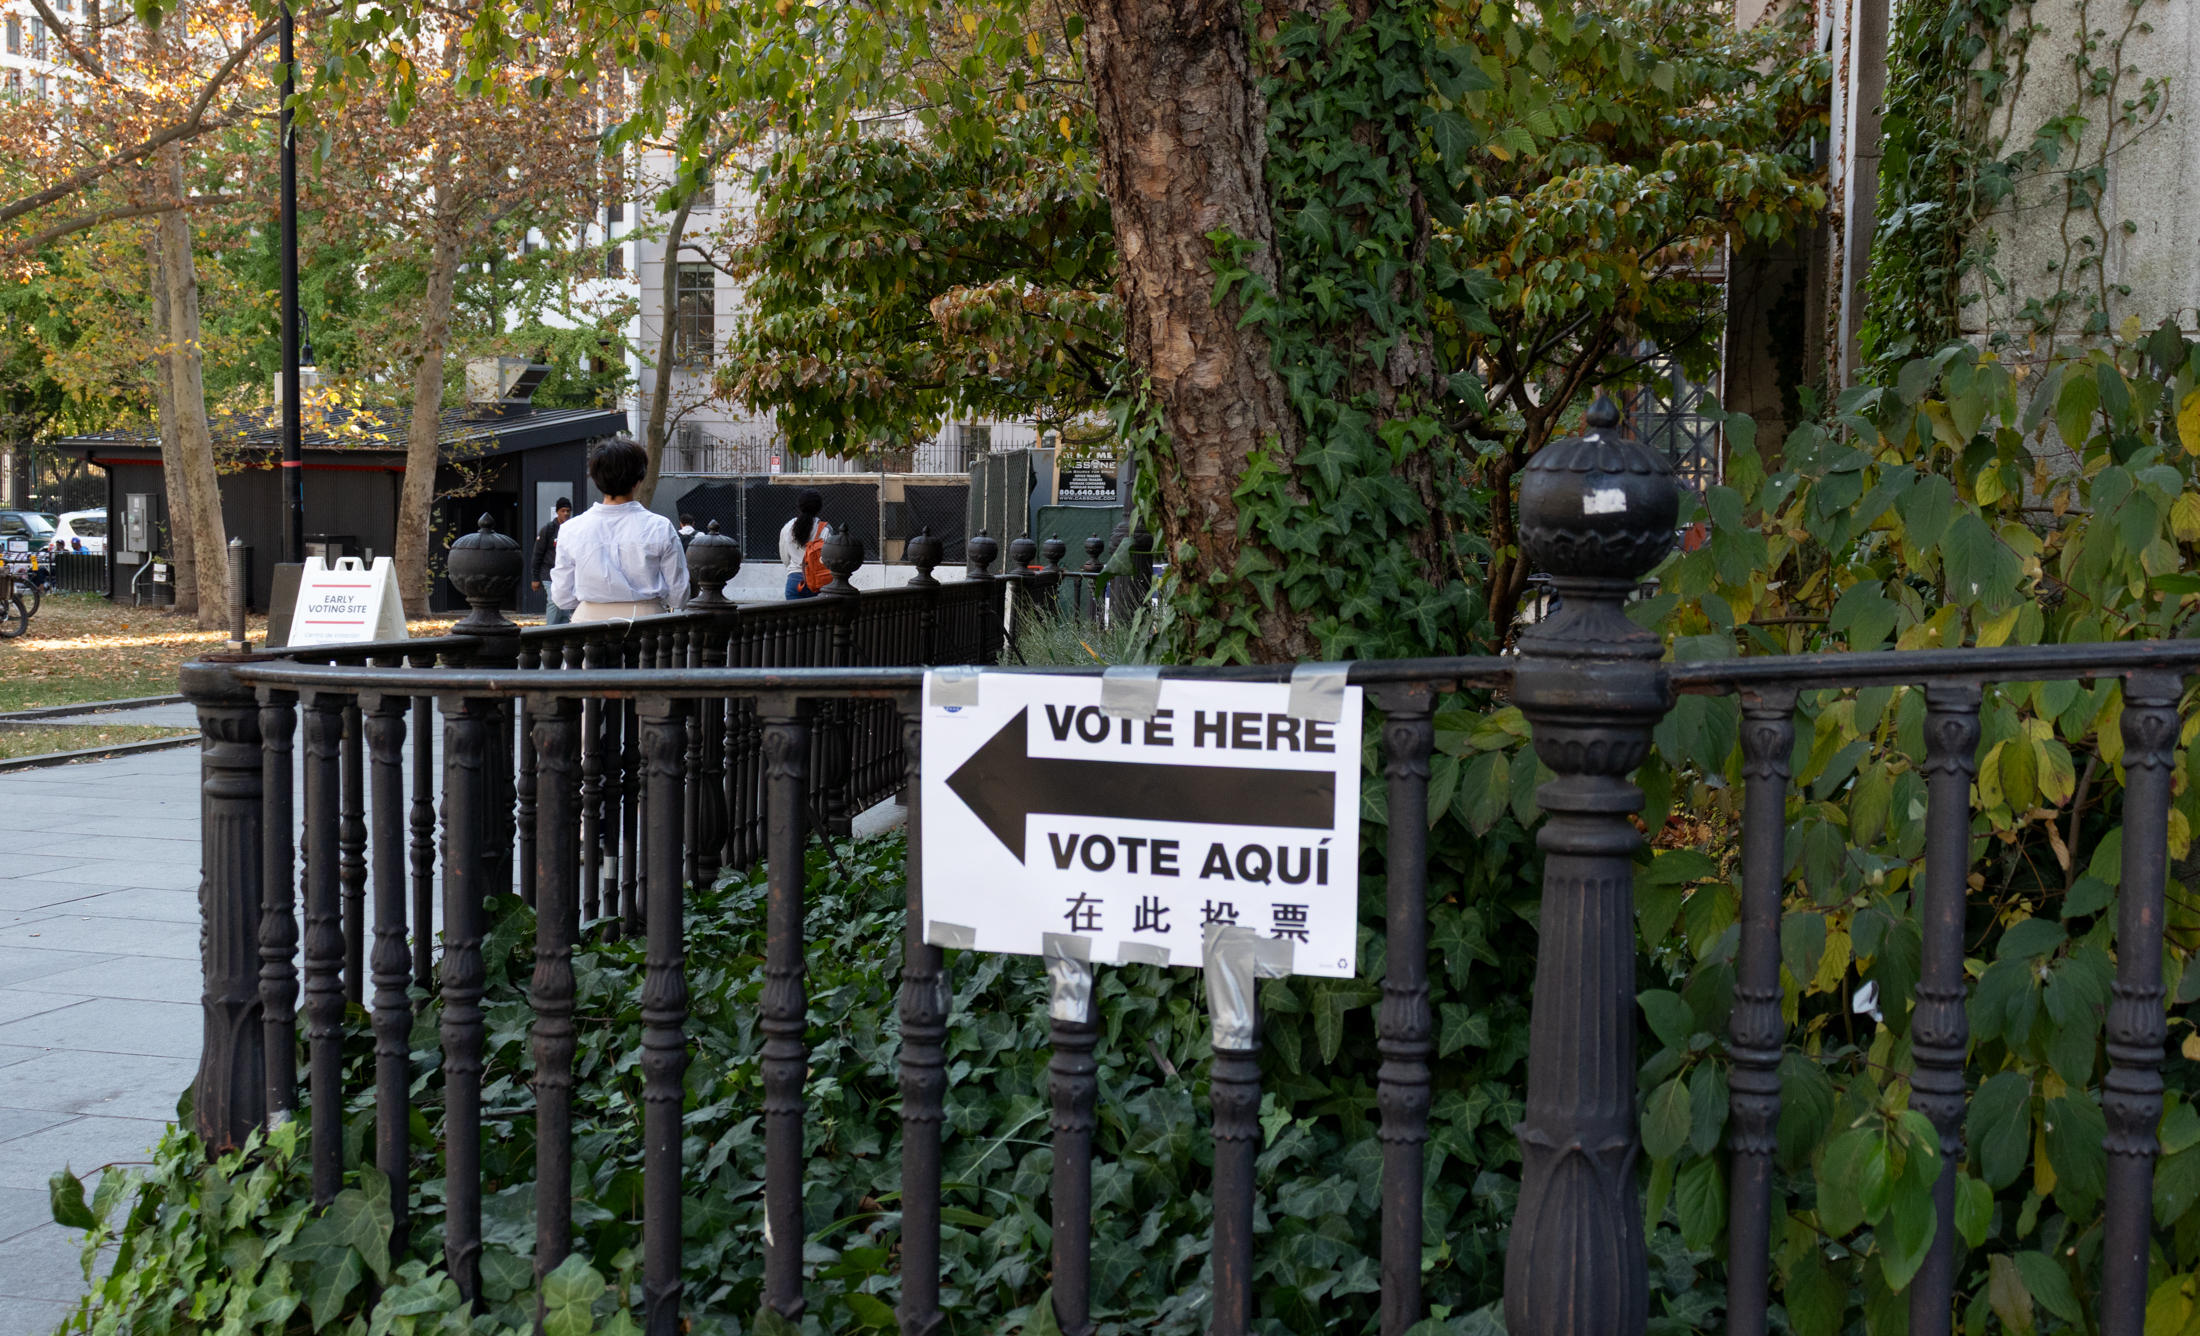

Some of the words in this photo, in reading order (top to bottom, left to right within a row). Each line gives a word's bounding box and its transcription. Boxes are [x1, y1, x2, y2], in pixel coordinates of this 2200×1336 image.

[1062, 460, 1116, 470] SSONE
[324, 595, 355, 604] EARLY
[308, 604, 346, 613] VOTING
[347, 605, 367, 613] SITE
[1194, 710, 1336, 753] HERE
[1048, 832, 1180, 877] VOTE
[1199, 837, 1333, 886] AQUÍ
